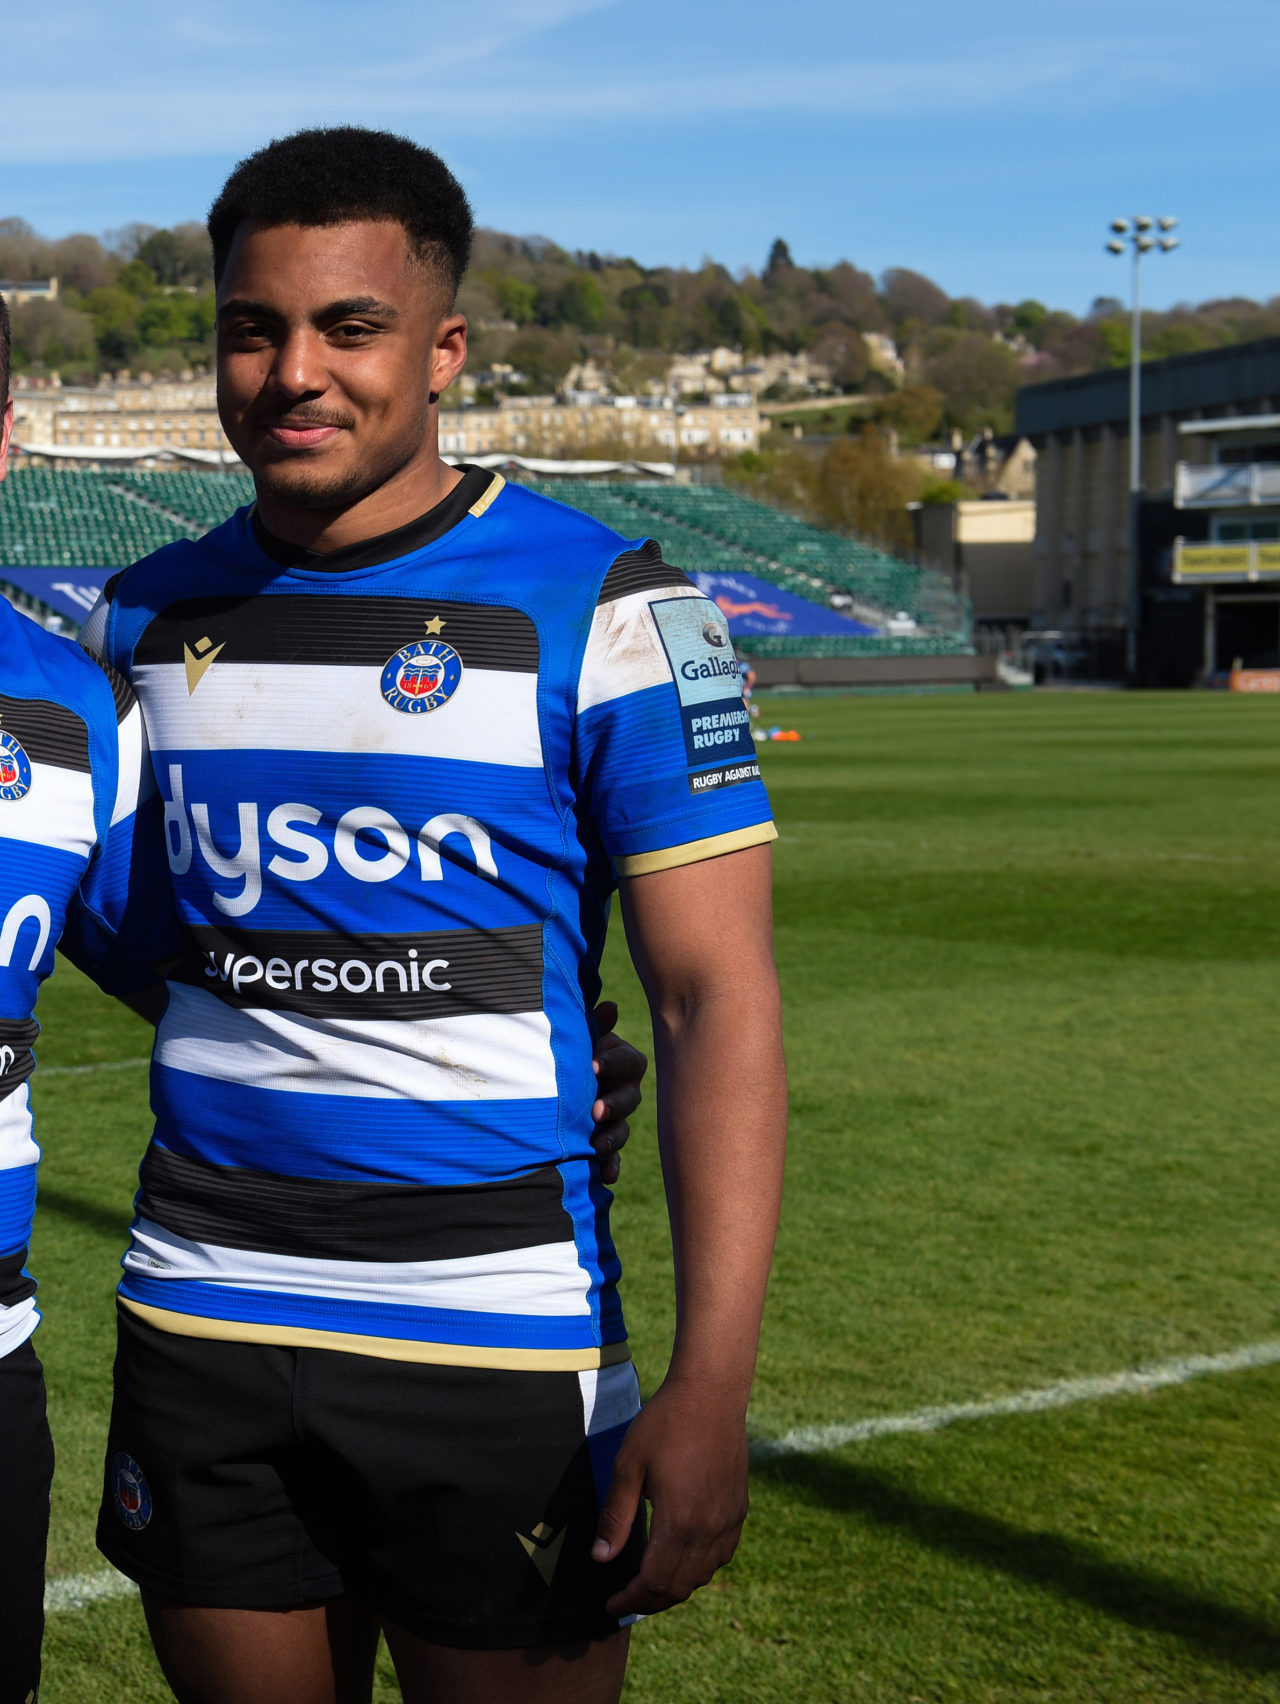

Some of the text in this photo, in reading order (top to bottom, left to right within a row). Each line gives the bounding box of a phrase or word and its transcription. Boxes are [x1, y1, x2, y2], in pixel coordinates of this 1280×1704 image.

[397, 642, 456, 663] BATH
[383, 686, 449, 713] RUGBY
[693, 728, 740, 750] RUGBY
[693, 772, 724, 789] RUGBY
[724, 765, 754, 782] AGAINST
[163, 764, 499, 917] dyson
[204, 948, 453, 994] upersonic
